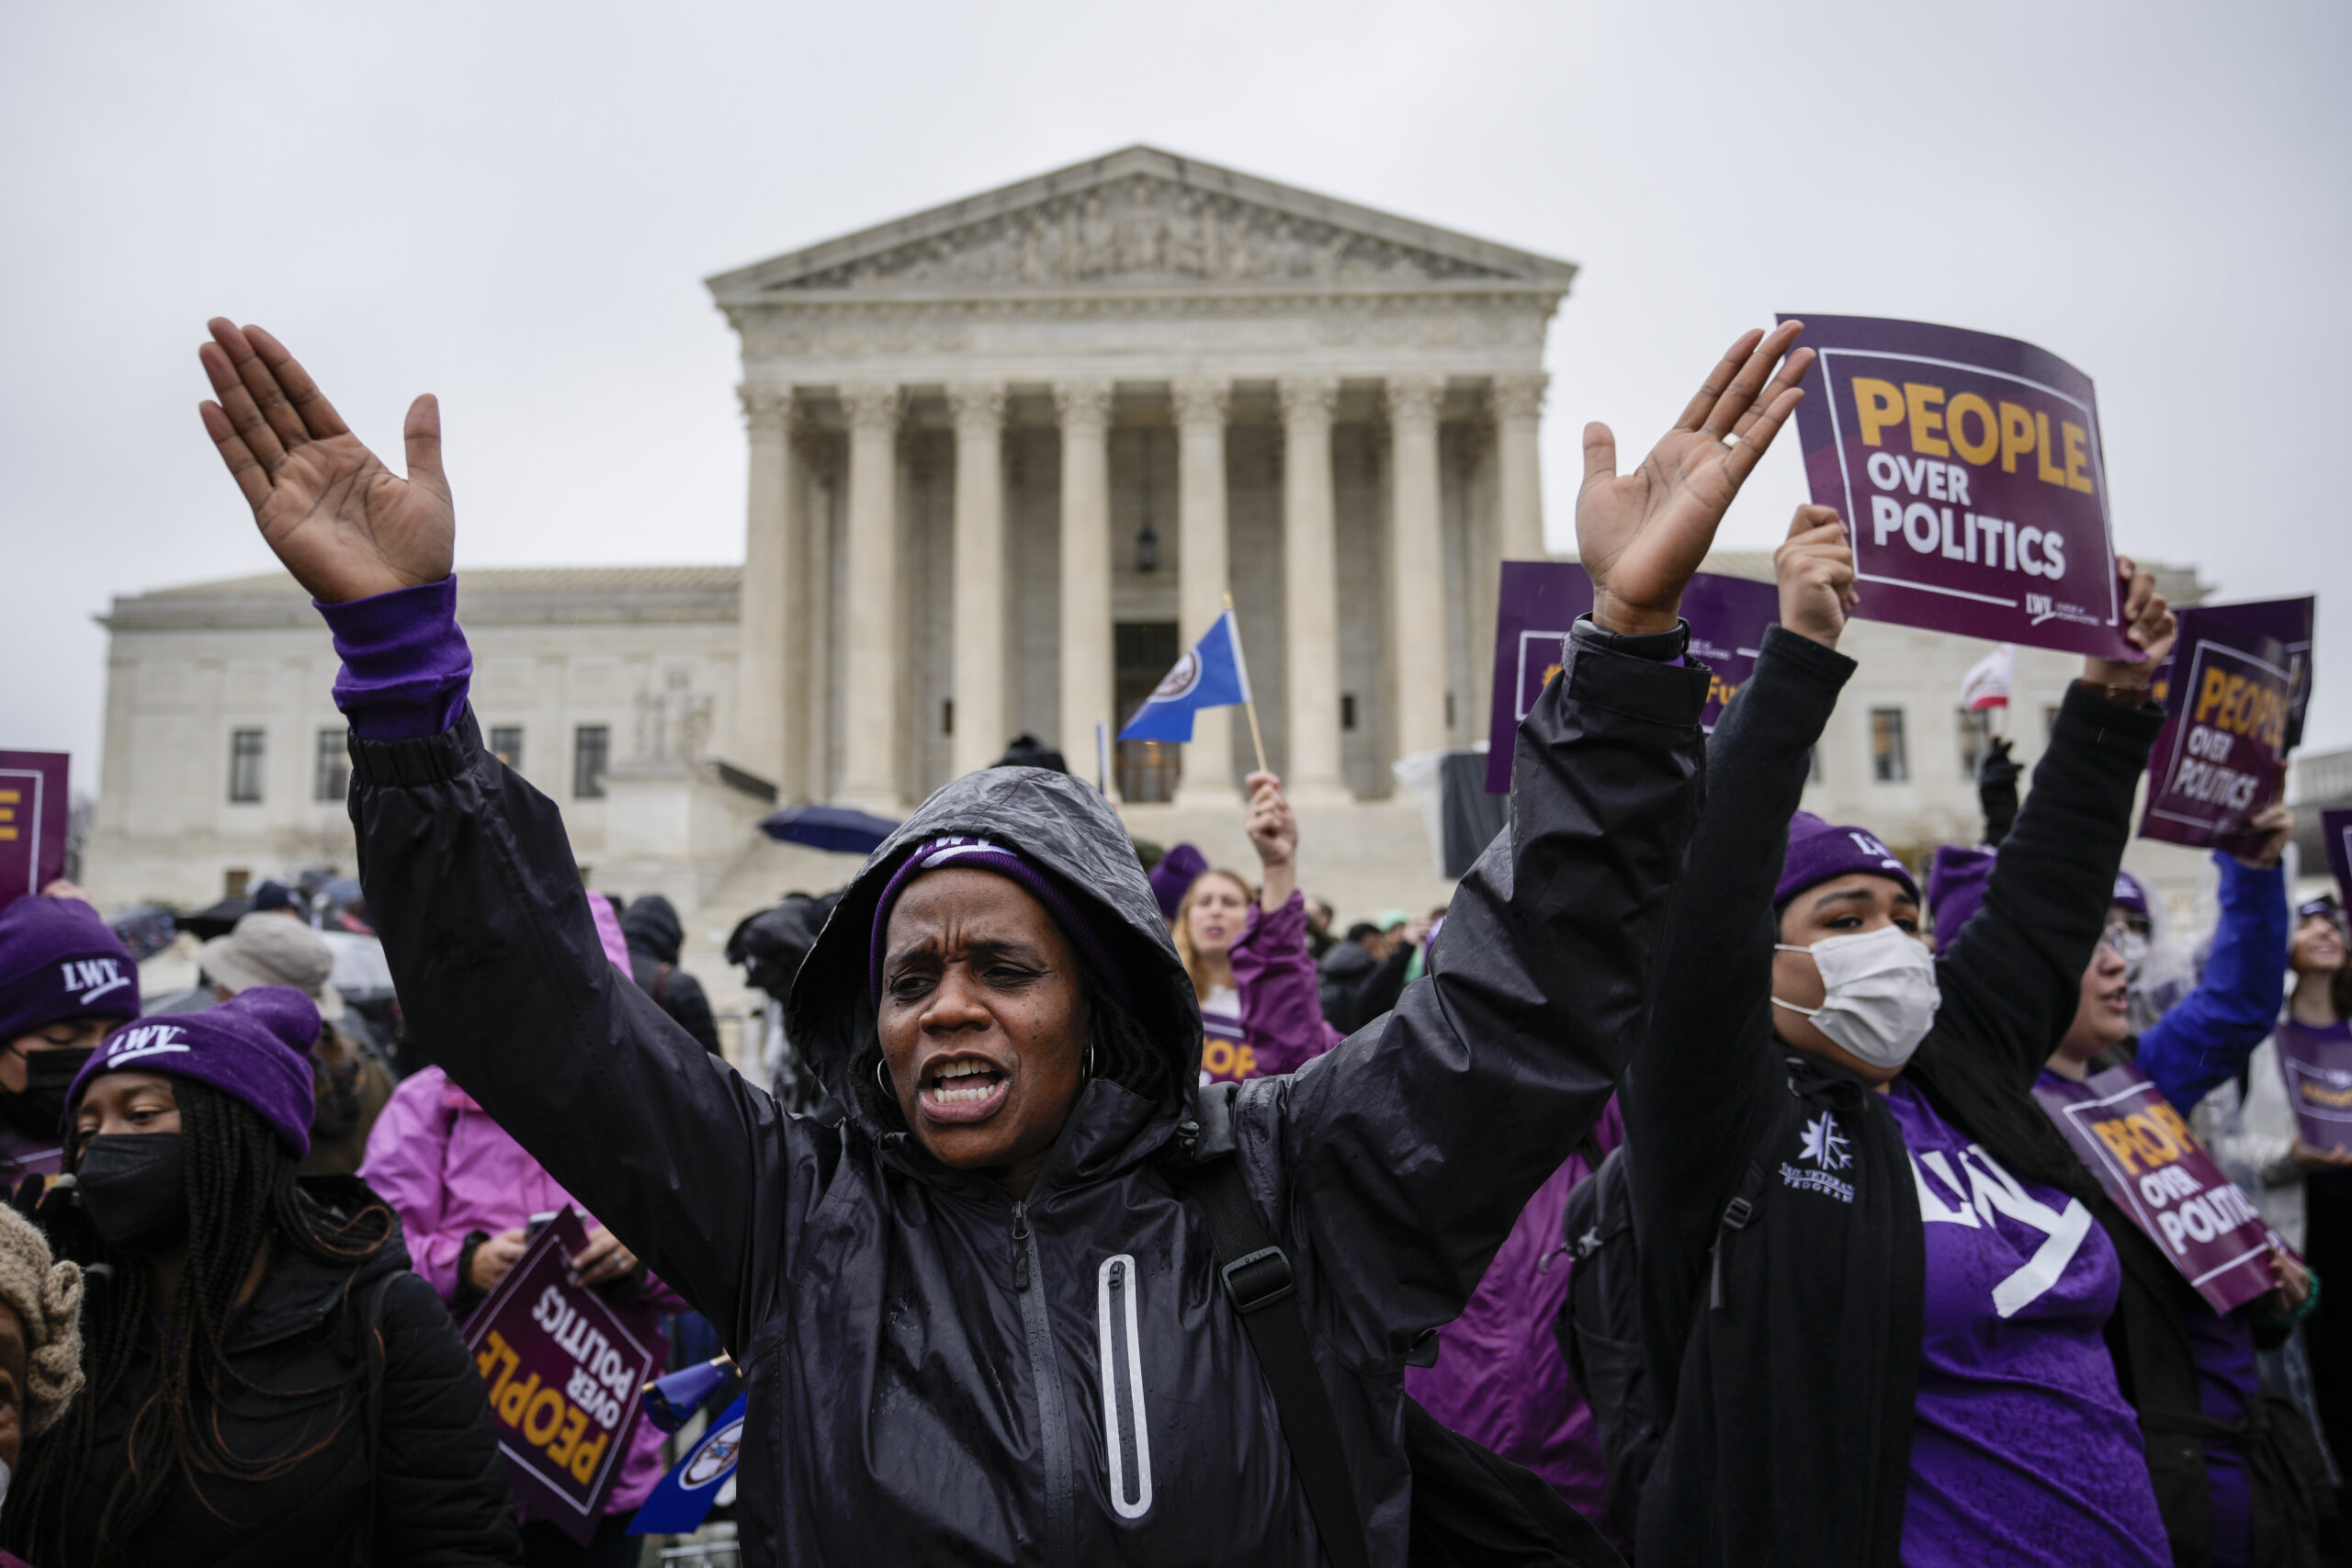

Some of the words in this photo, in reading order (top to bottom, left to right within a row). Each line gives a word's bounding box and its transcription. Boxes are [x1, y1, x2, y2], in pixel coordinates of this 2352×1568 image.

[1851, 378, 2094, 495] PEOPLE
[1867, 451, 1972, 506] OVER
[1871, 494, 2066, 581] POLITICS
[2188, 725, 2234, 763] OVER
[2170, 756, 2259, 811] POLITICS
[61, 958, 130, 1005] LWV
[107, 1025, 191, 1068] LWV
[2091, 1102, 2193, 1176] PEOP
[2140, 1165, 2204, 1209] OVER
[531, 1285, 636, 1404] POLITICS
[475, 1329, 608, 1486] PEOPLE
[566, 1366, 621, 1429] OVER
